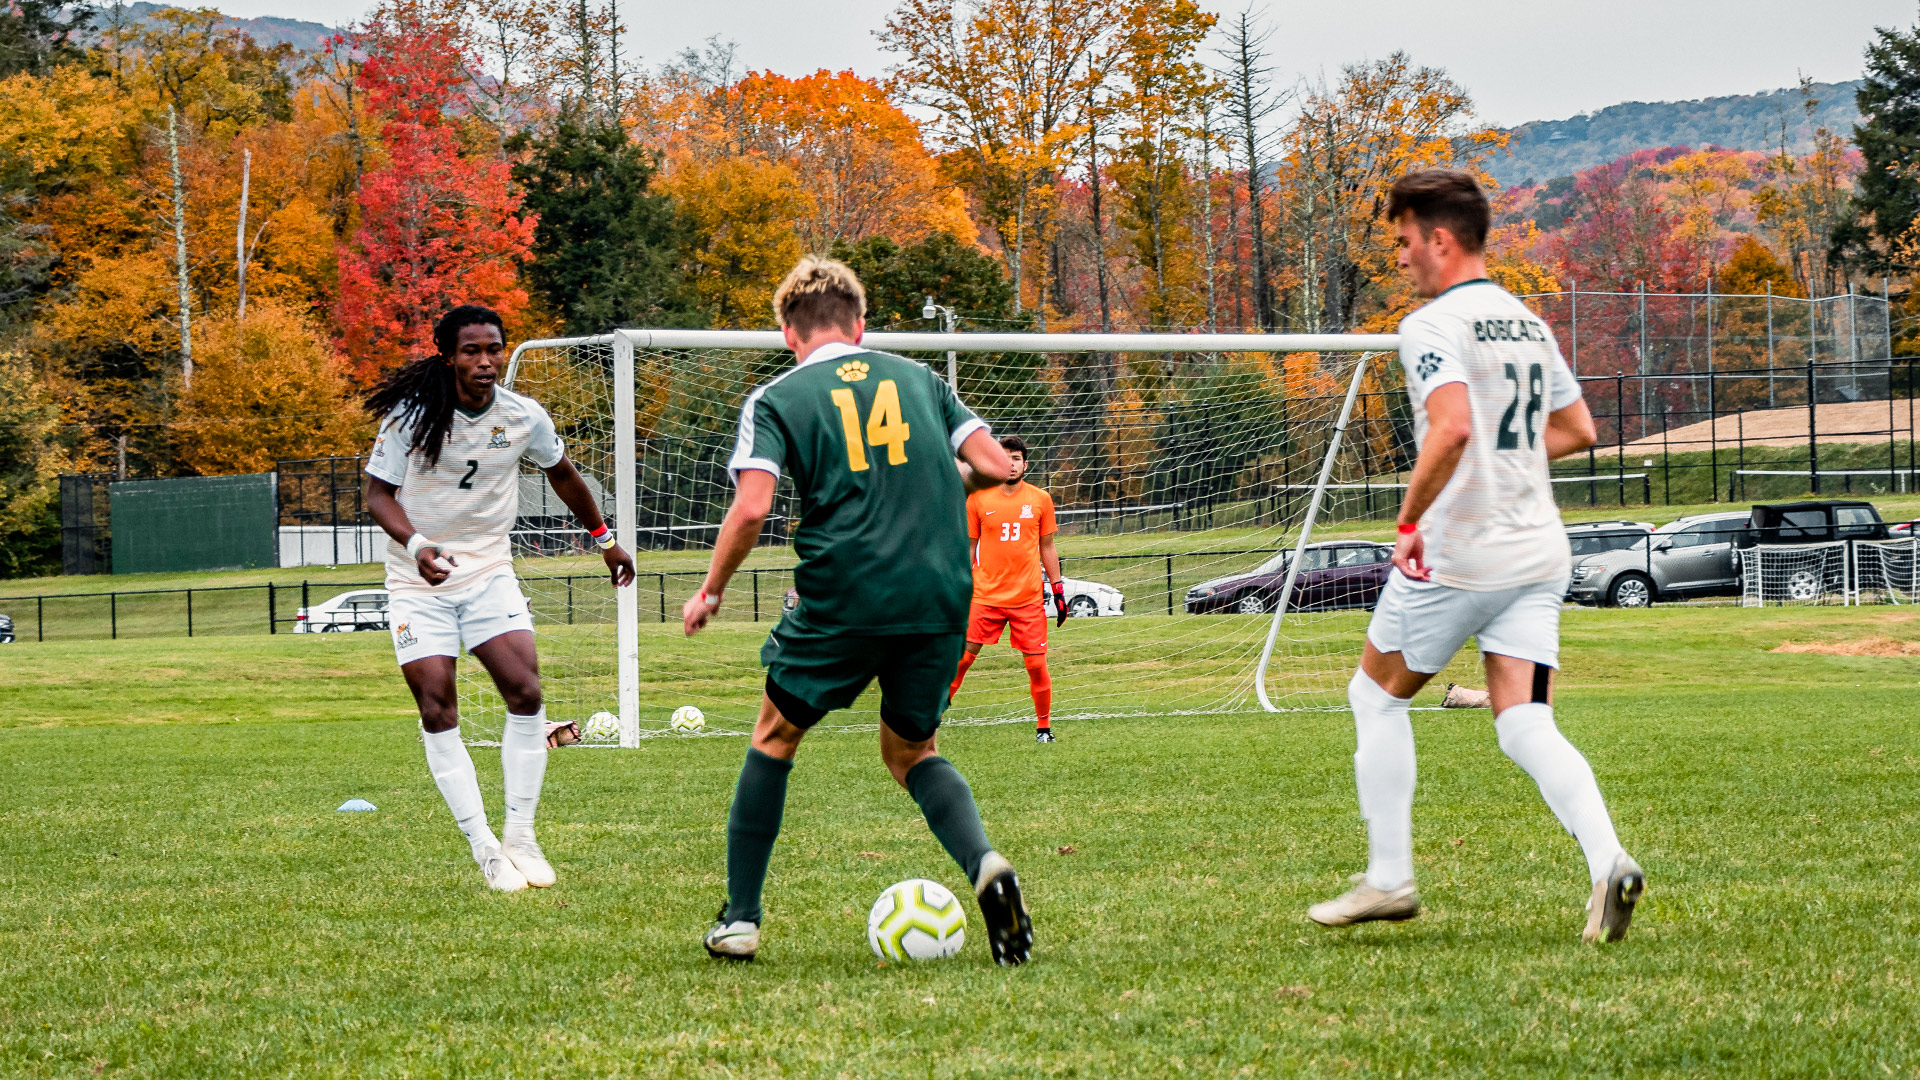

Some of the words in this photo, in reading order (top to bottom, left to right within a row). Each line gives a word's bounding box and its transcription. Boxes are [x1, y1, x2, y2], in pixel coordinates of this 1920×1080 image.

[1474, 319, 1547, 342] BOBCATS
[1496, 362, 1543, 451] 28
[830, 379, 910, 472] 14
[458, 459, 479, 490] 2
[1000, 522, 1021, 541] 33
